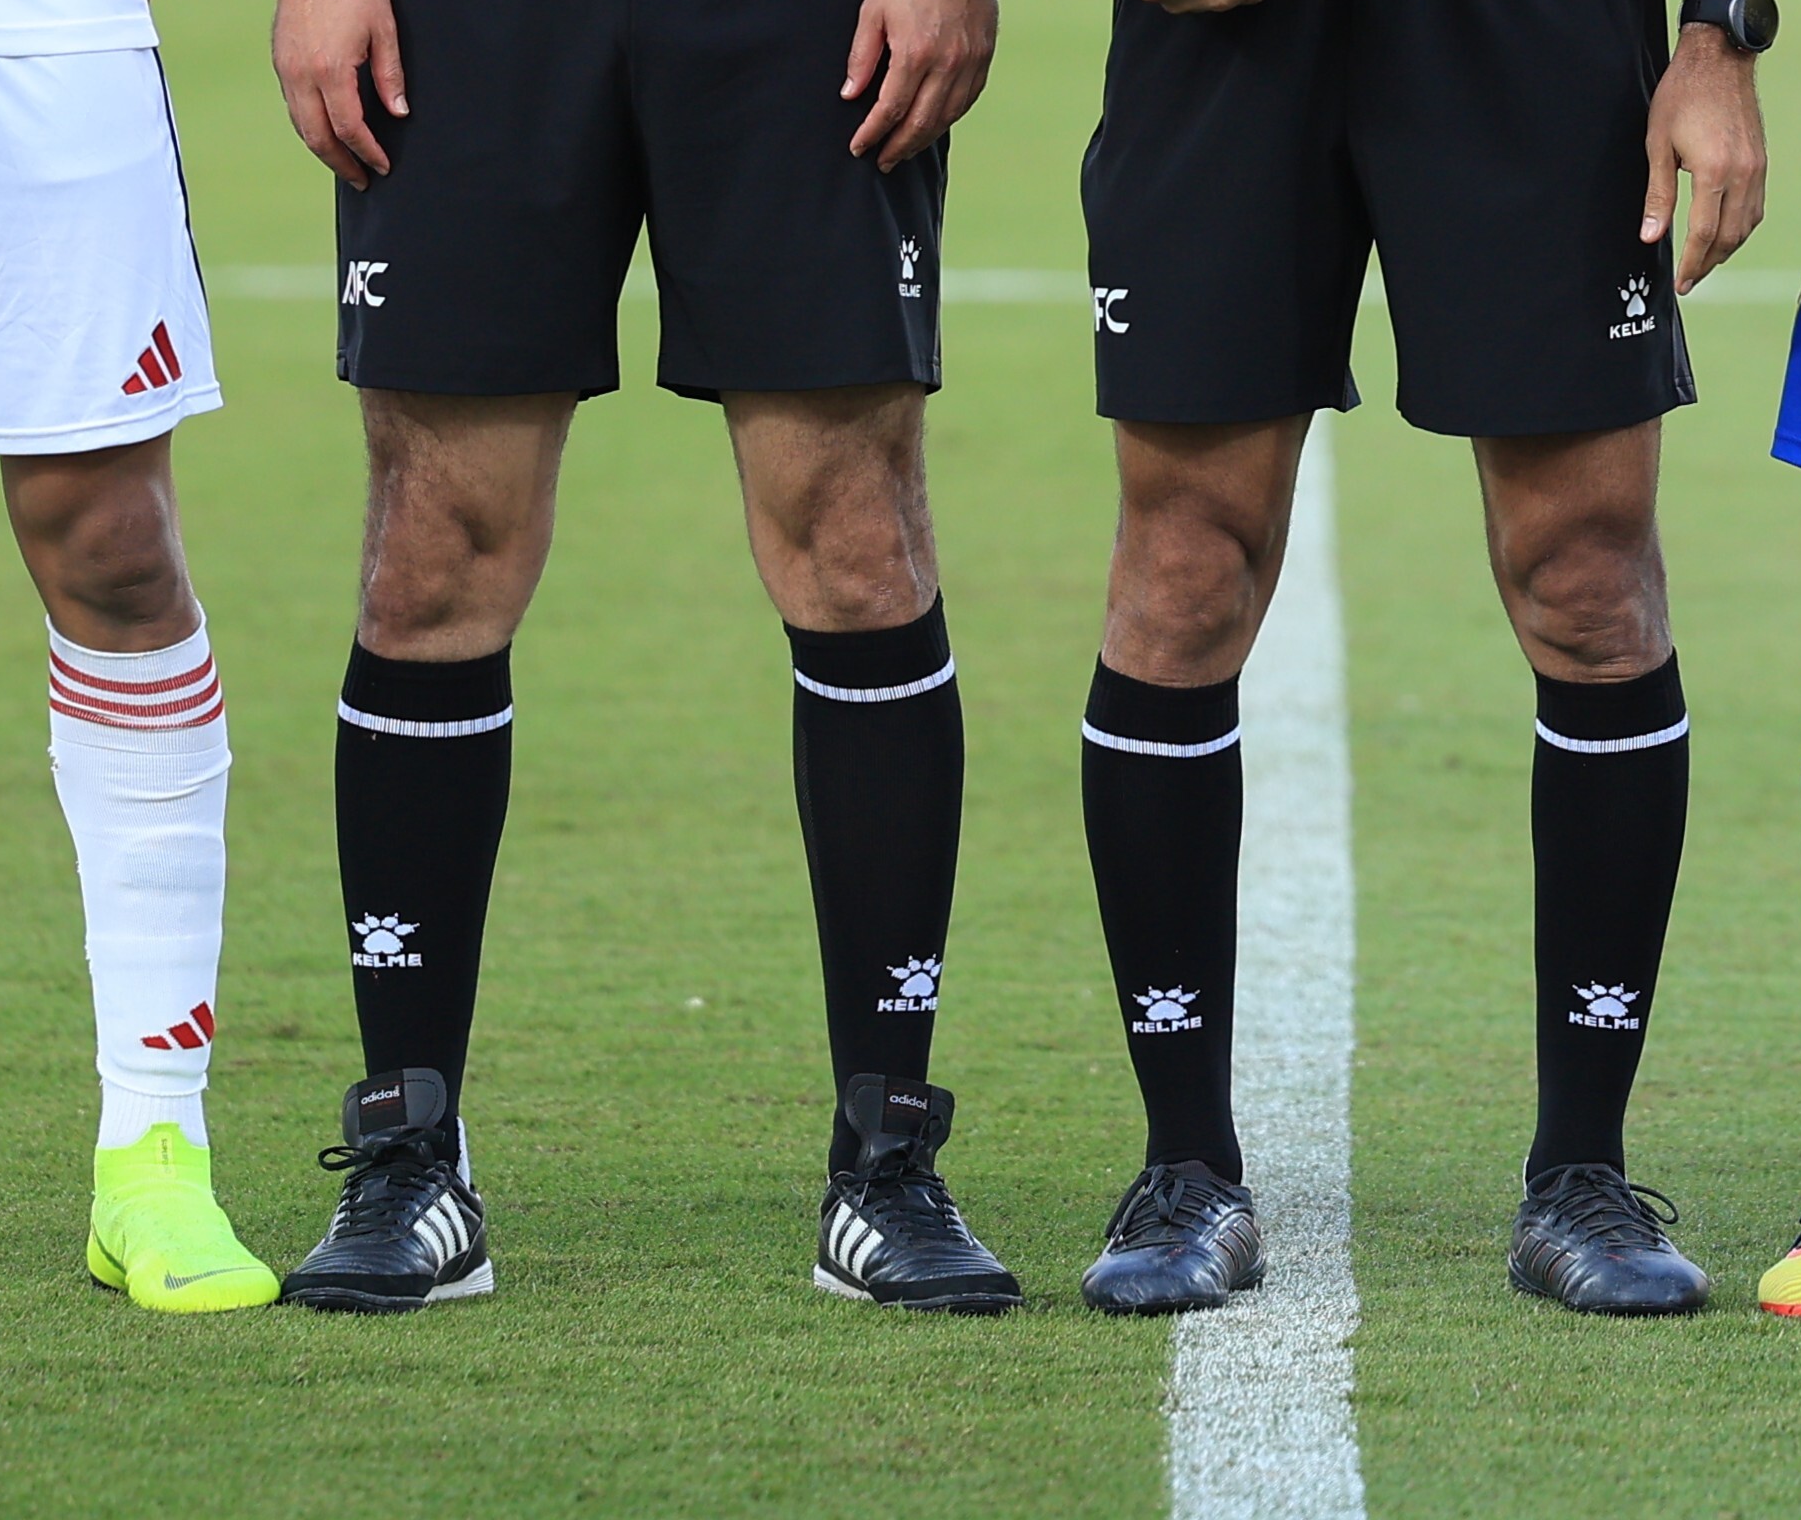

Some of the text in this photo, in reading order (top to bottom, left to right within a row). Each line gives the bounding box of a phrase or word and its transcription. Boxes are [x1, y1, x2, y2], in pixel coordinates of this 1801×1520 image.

[341, 260, 389, 308] AFC
[1091, 287, 1130, 334] FC
[1609, 315, 1656, 339] KELME
[352, 952, 423, 968] KELME
[1132, 1015, 1203, 1034] KELME
[1568, 1010, 1640, 1031] KELME
[361, 1085, 400, 1105] adidas
[889, 1094, 928, 1110] adidas
